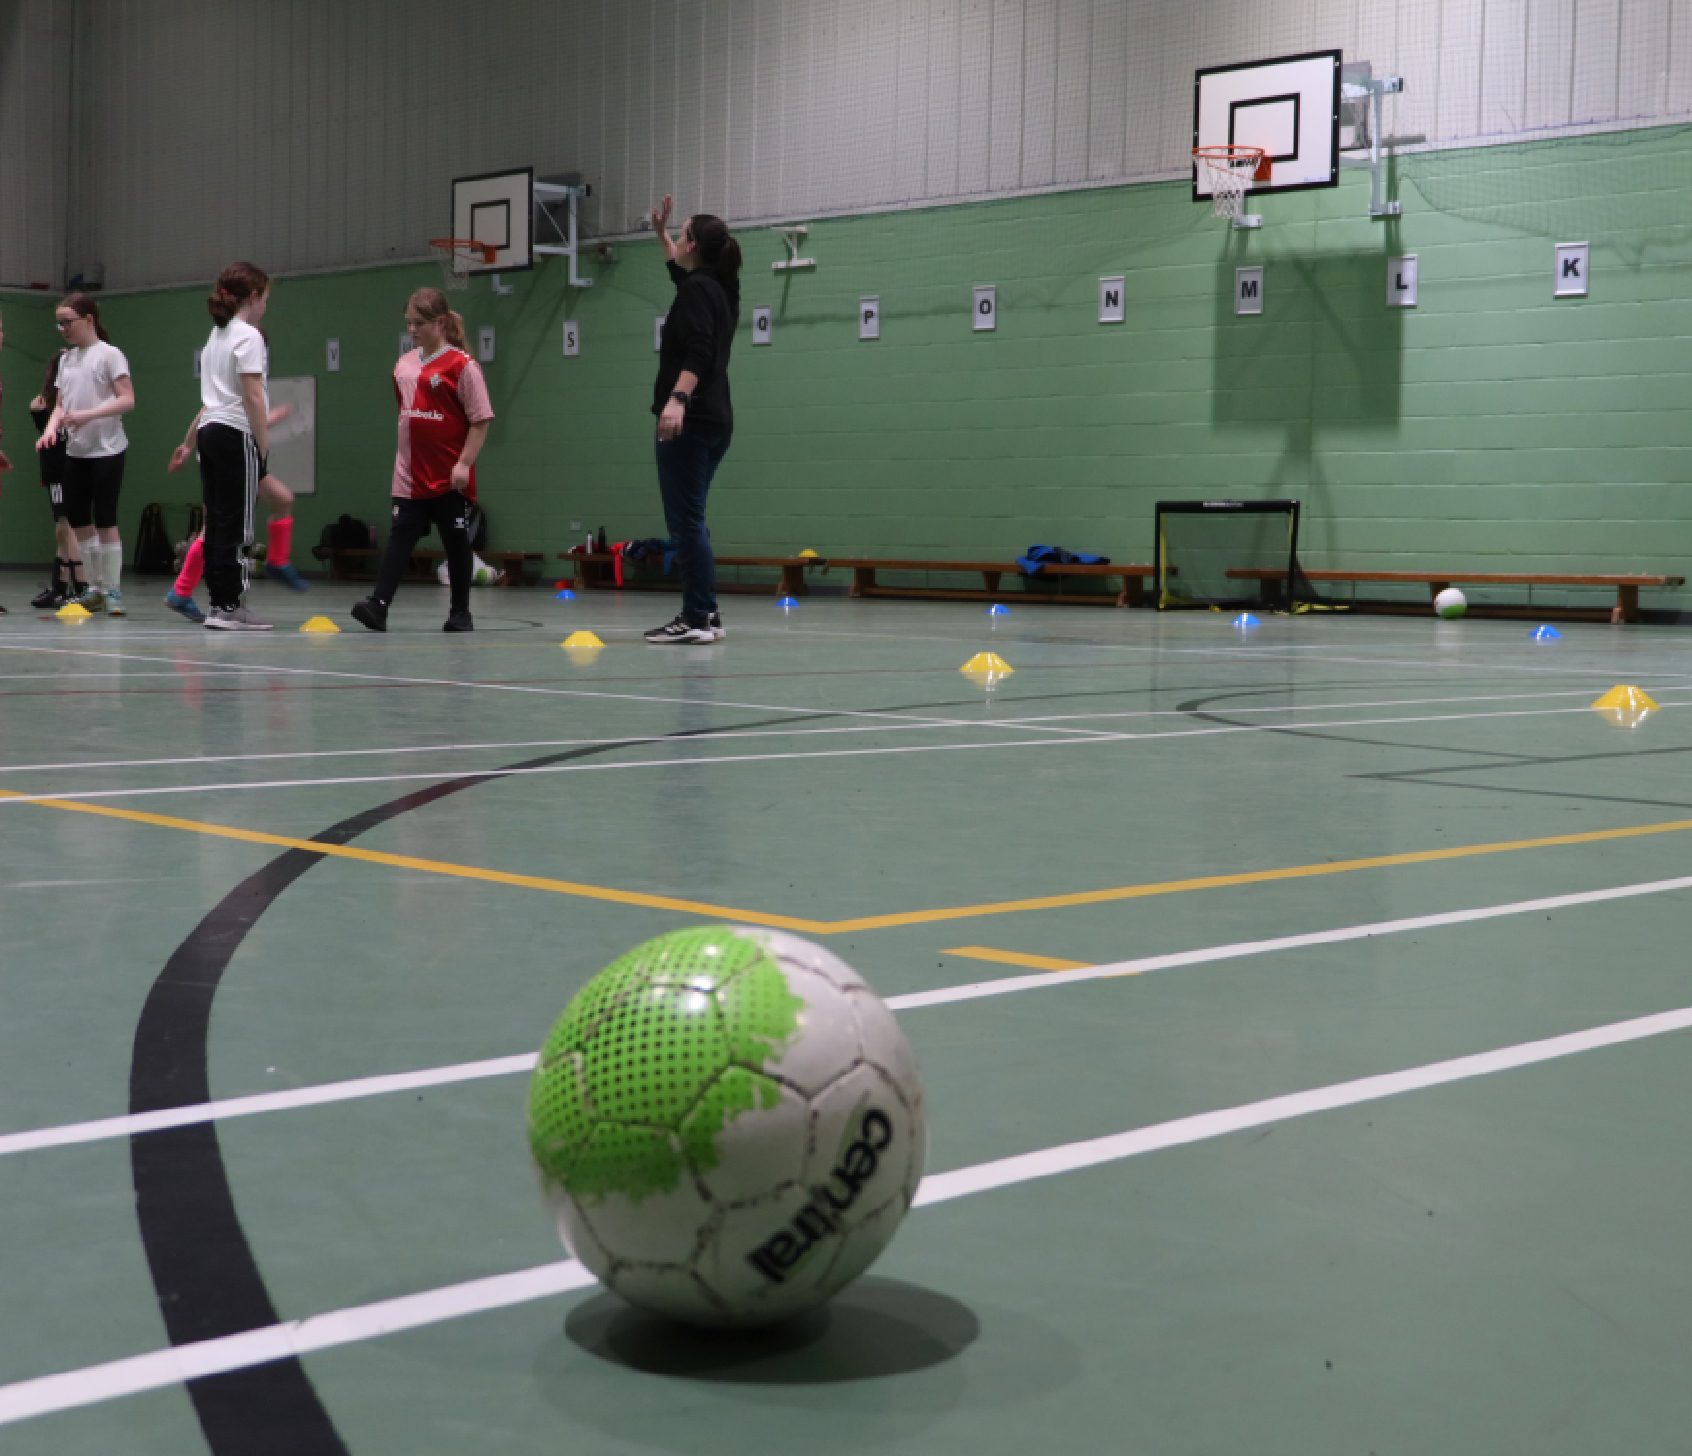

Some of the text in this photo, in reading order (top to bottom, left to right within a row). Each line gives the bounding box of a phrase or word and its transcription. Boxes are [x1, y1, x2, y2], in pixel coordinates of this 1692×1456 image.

[1563, 258, 1580, 277] K
[1241, 280, 1258, 298] M
[1397, 273, 1408, 290] L
[1105, 289, 1119, 307] N
[979, 299, 992, 315] O
[864, 310, 874, 324] P
[482, 337, 492, 350] T
[567, 331, 575, 348] S
[745, 1109, 892, 1284] central
